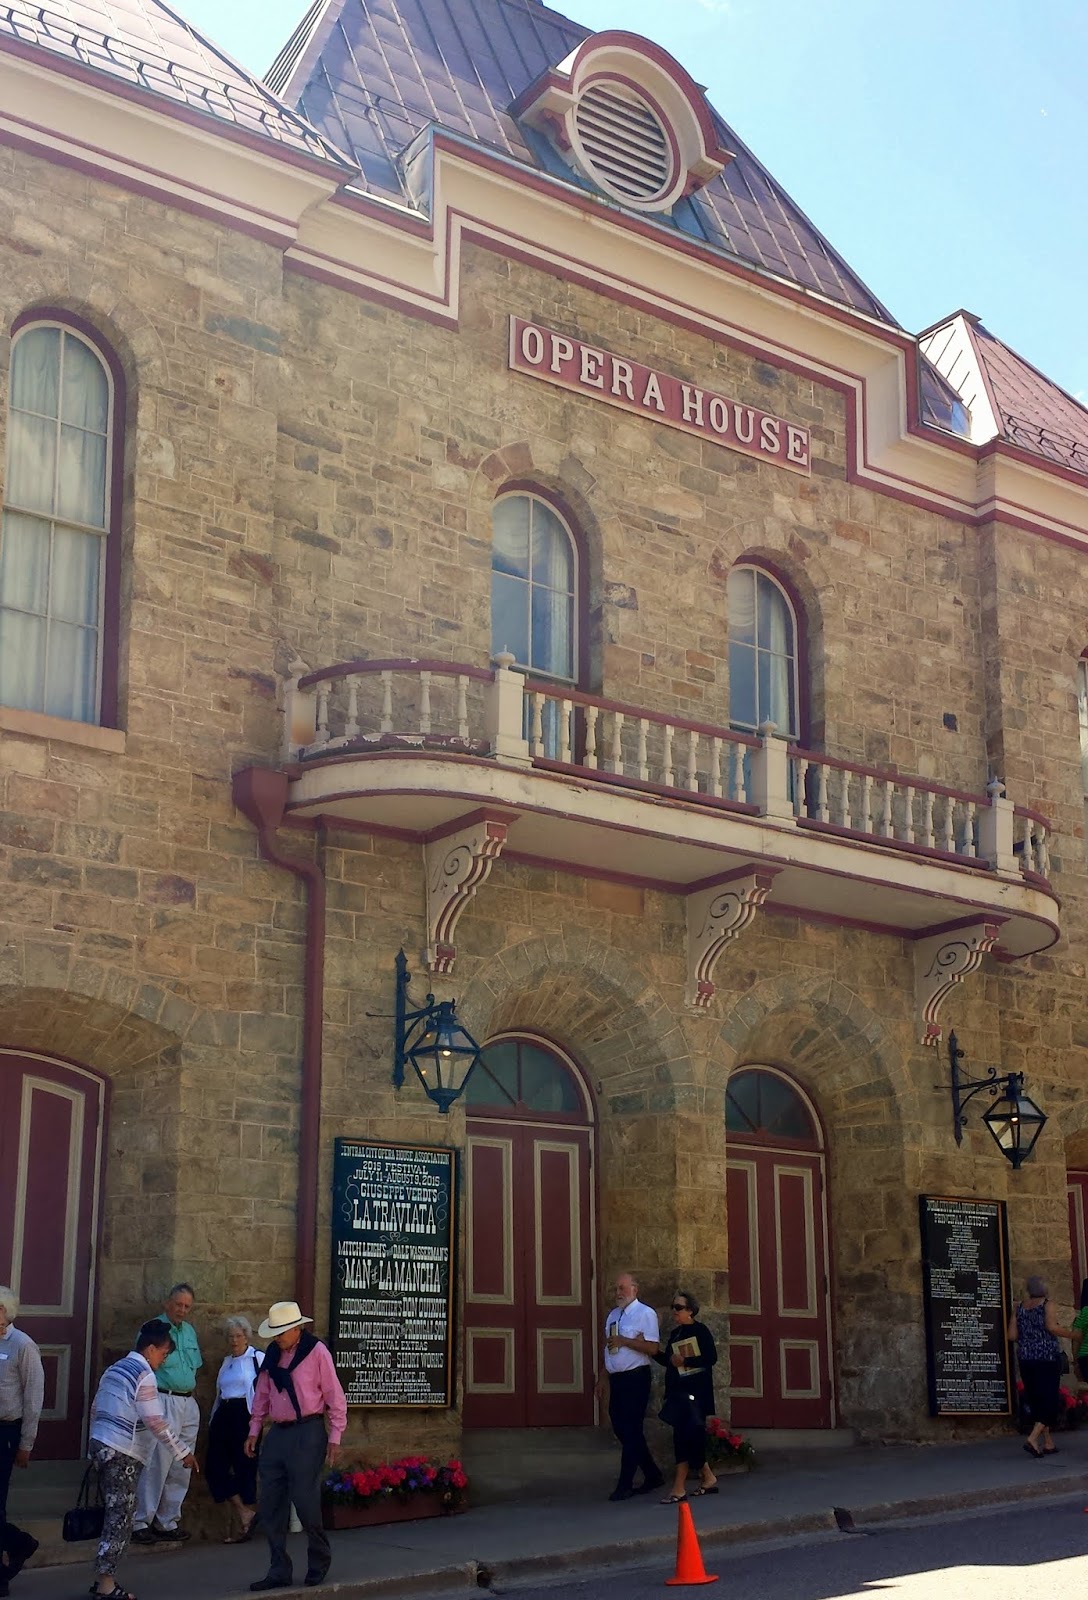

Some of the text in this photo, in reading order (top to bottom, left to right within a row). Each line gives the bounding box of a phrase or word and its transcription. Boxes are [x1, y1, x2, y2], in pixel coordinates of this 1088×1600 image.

[521, 326, 808, 466] OPERA HOUSE
[378, 1148, 395, 1160] OPERA
[395, 1149, 413, 1161] HOUSE
[414, 1151, 450, 1165] ASSOCIATION
[353, 1169, 375, 1180] JULY
[362, 1160, 428, 1175] 2015 FESTIVAL
[360, 1183, 438, 1203] GIUSEPPE VERDI'S
[353, 1198, 437, 1235] LA TRAVIATA
[964, 1214, 988, 1227] ARTISTS
[338, 1240, 362, 1257] MITCH
[362, 1242, 387, 1259] LEIGH'S
[392, 1244, 409, 1260] DALE
[409, 1245, 449, 1262] WASSERMAN'S
[345, 1257, 372, 1289] MAN
[379, 1259, 393, 1290] LA
[393, 1261, 441, 1293] MANCHA
[402, 1296, 418, 1318] DON
[338, 1320, 372, 1339] BENJAMIN
[434, 1320, 447, 1341] SON
[366, 1340, 400, 1351] FESTIVAL
[400, 1341, 428, 1351] EXTRAS
[336, 1351, 444, 1369] LUNCH & A SONG SHORT WORKS
[355, 1370, 384, 1382] PELHAM
[404, 1382, 431, 1392] DIRECTOR
[353, 1393, 372, 1403] OFFICE
[375, 1393, 398, 1403] LOCATED
[407, 1393, 426, 1403] TELLER
[427, 1393, 445, 1403] HOUSE
